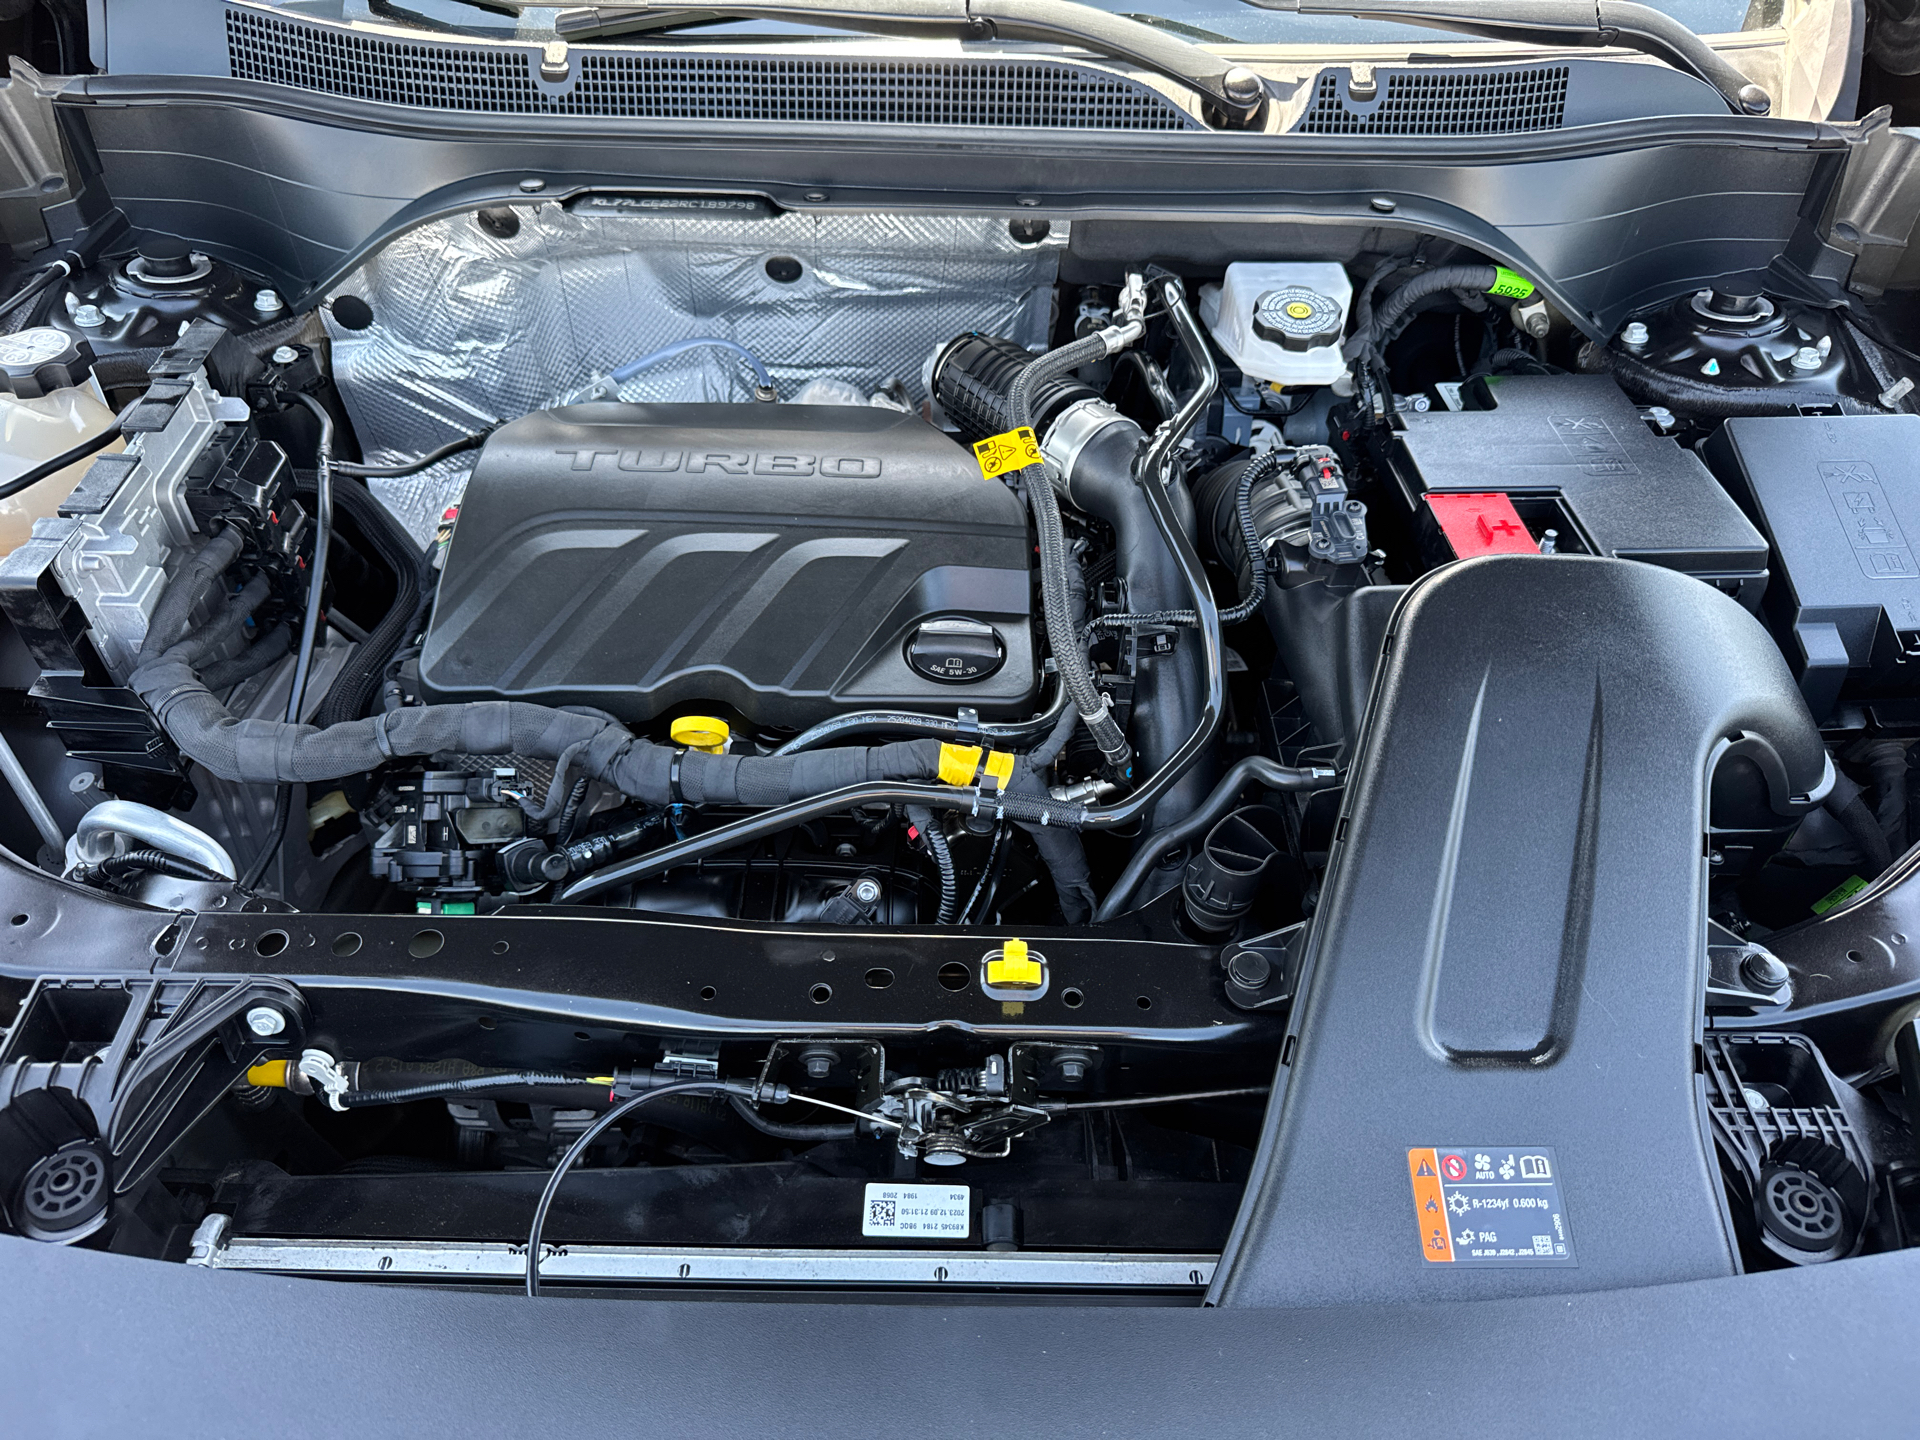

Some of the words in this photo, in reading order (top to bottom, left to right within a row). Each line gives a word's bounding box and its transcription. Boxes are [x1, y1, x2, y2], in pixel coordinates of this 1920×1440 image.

[555, 449, 882, 479] TURBO
[930, 664, 946, 674] SAE
[949, 666, 977, 675] 5W-30
[1475, 1171, 1495, 1180] AUTO
[1472, 1198, 1509, 1211] R-1234yf
[1513, 1198, 1536, 1208] 0.600
[1537, 1198, 1549, 1210] kg
[901, 1208, 928, 1216] 21:31:50
[1478, 1231, 1497, 1243] PAG
